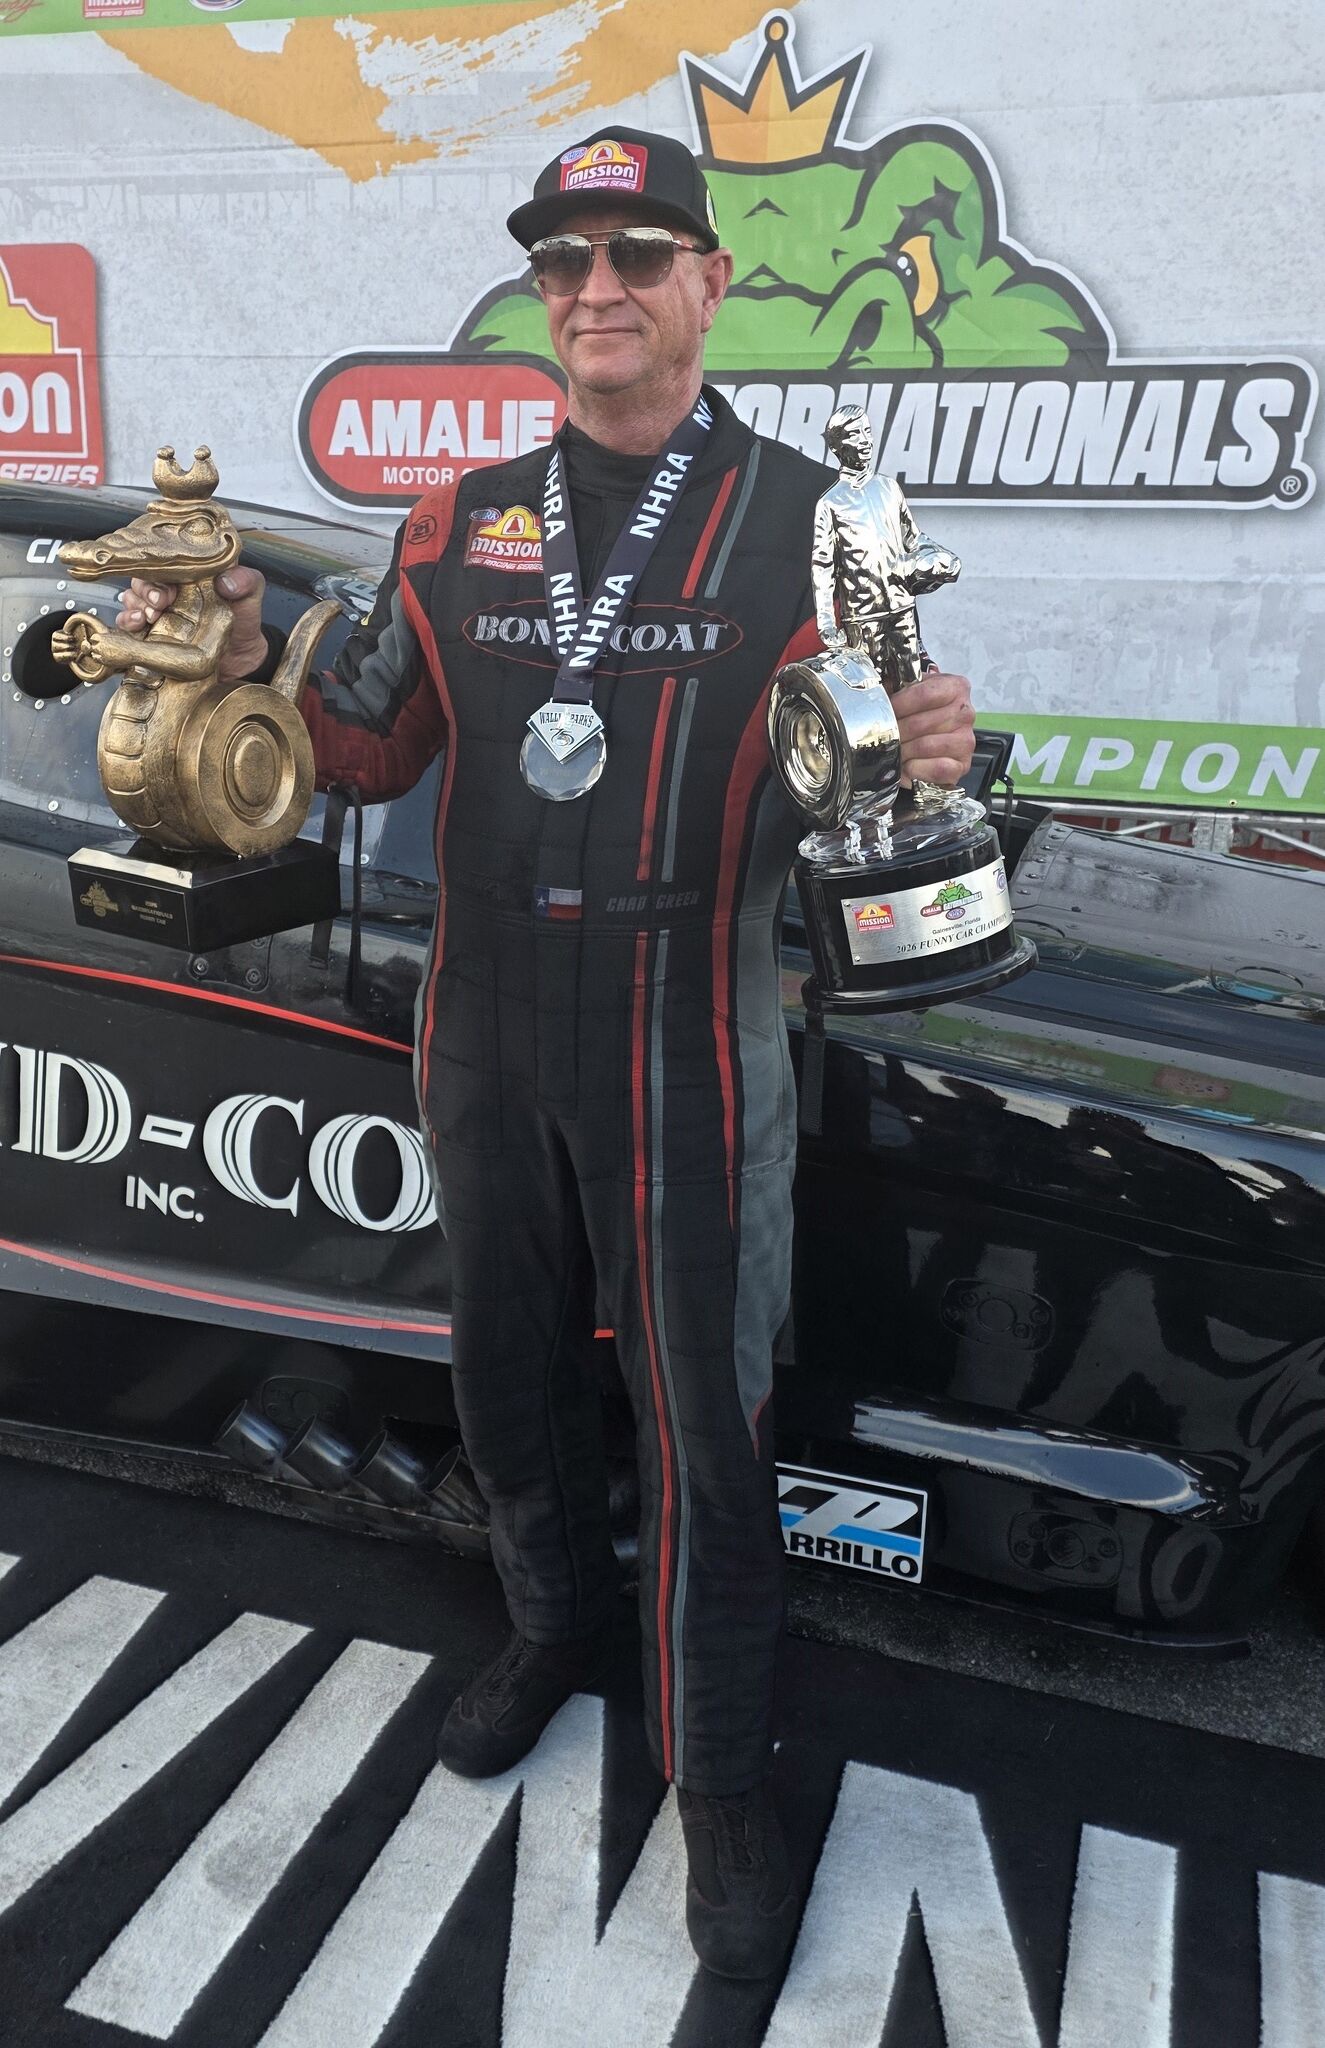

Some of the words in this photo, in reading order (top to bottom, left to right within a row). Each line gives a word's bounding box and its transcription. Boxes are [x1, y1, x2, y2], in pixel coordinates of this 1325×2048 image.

[328, 399, 555, 459] AMALIE
[382, 466, 455, 486] MOTOR
[543, 451, 566, 541] NHRA
[629, 452, 693, 539] NHRA
[568, 574, 634, 667] NHRA
[606, 896, 647, 913] CHAD
[655, 890, 701, 911] GREEN
[919, 933, 955, 951] FUNNY
[955, 929, 974, 942] CAR
[0, 1042, 440, 1233] D-CO
[126, 1175, 204, 1223] INC.
[780, 1531, 919, 1579] RRILLO
